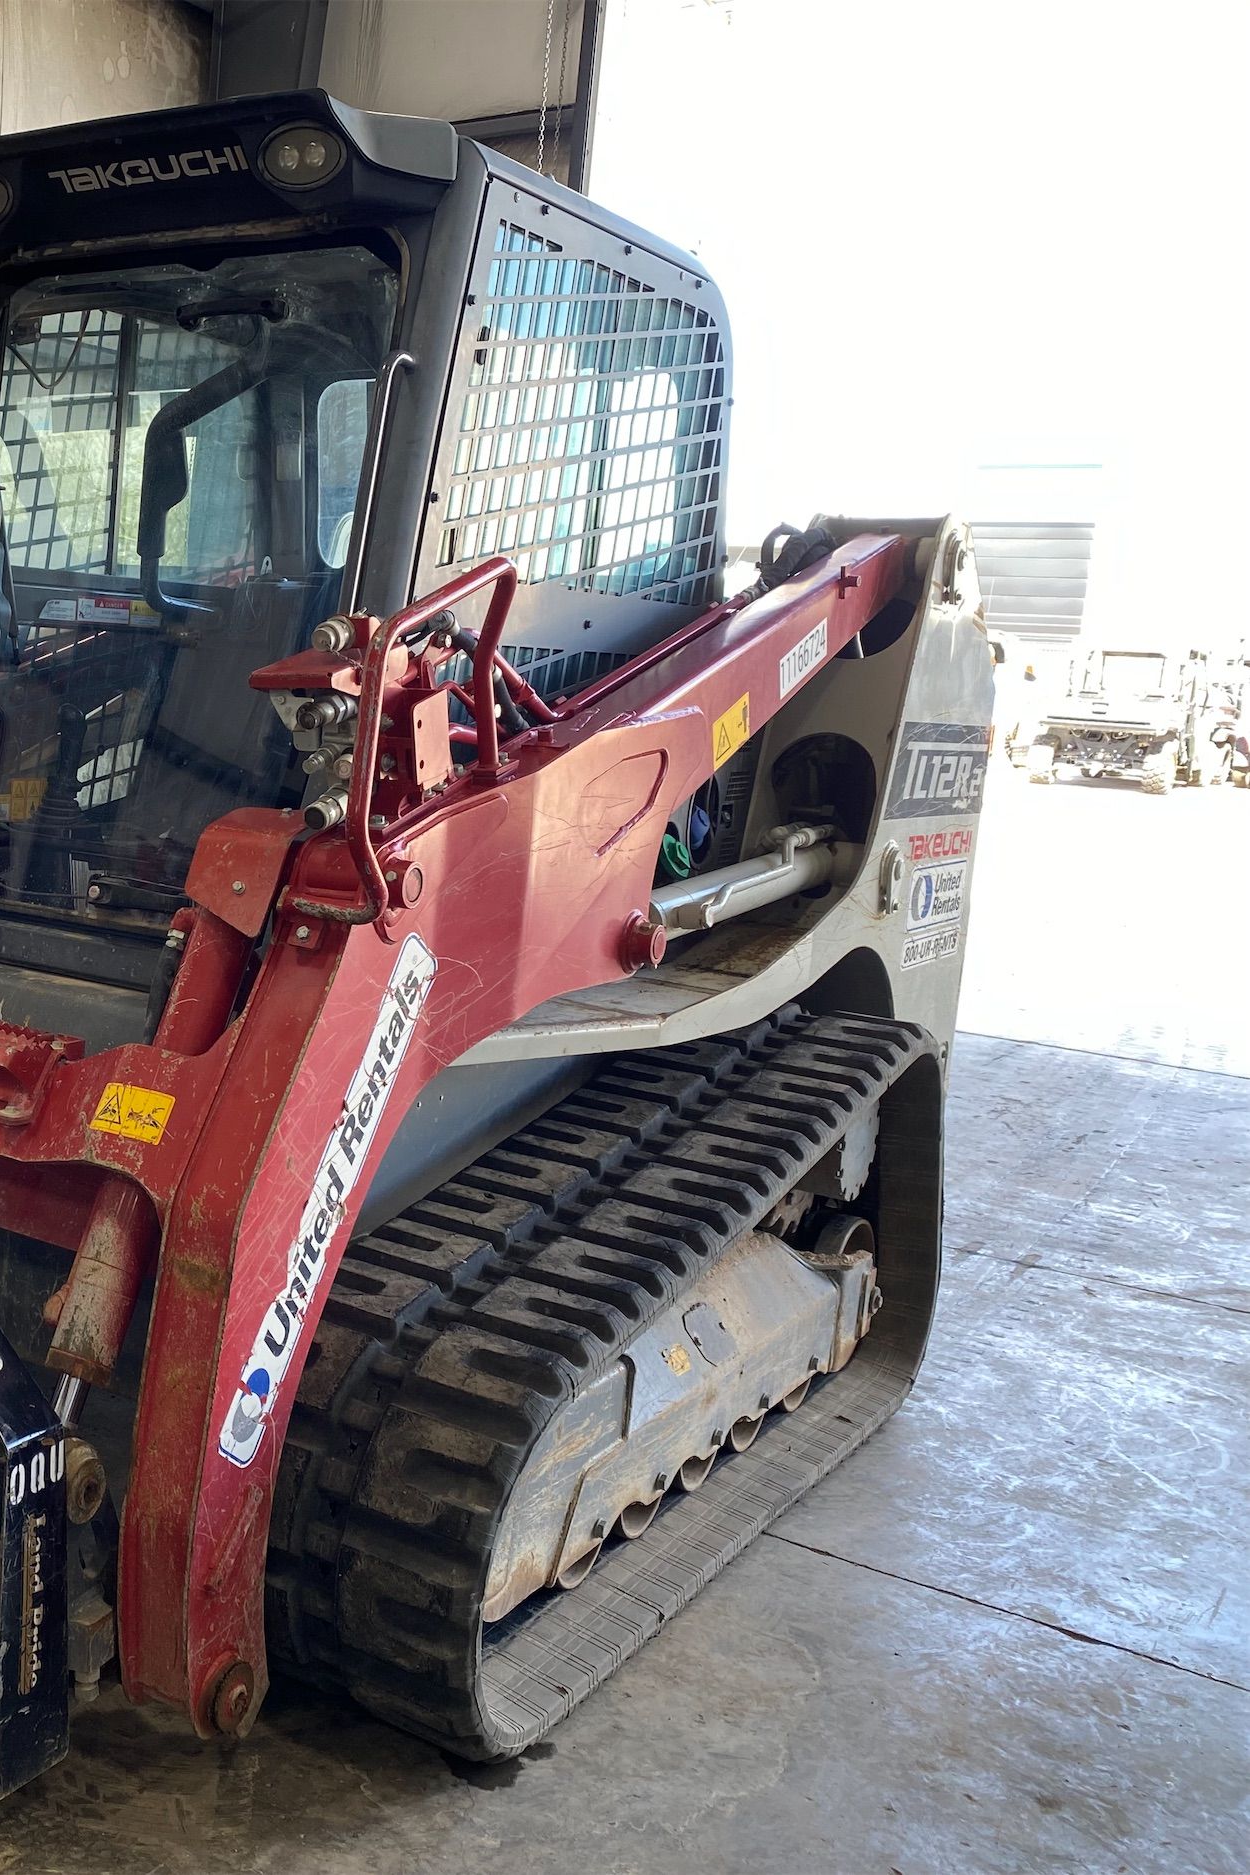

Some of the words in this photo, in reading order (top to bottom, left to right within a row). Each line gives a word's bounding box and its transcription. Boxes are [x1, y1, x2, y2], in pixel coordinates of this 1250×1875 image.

[48, 145, 249, 193] TAKEUCHI
[781, 623, 826, 690] 11166724
[908, 831, 972, 861] TAKEUCHI
[931, 893, 961, 918] Rentals
[934, 871, 961, 894] United
[262, 1161, 346, 1360] United
[337, 968, 424, 1168] Rentals
[27, 1512, 47, 1594] Land
[27, 1602, 46, 1689] Pride
